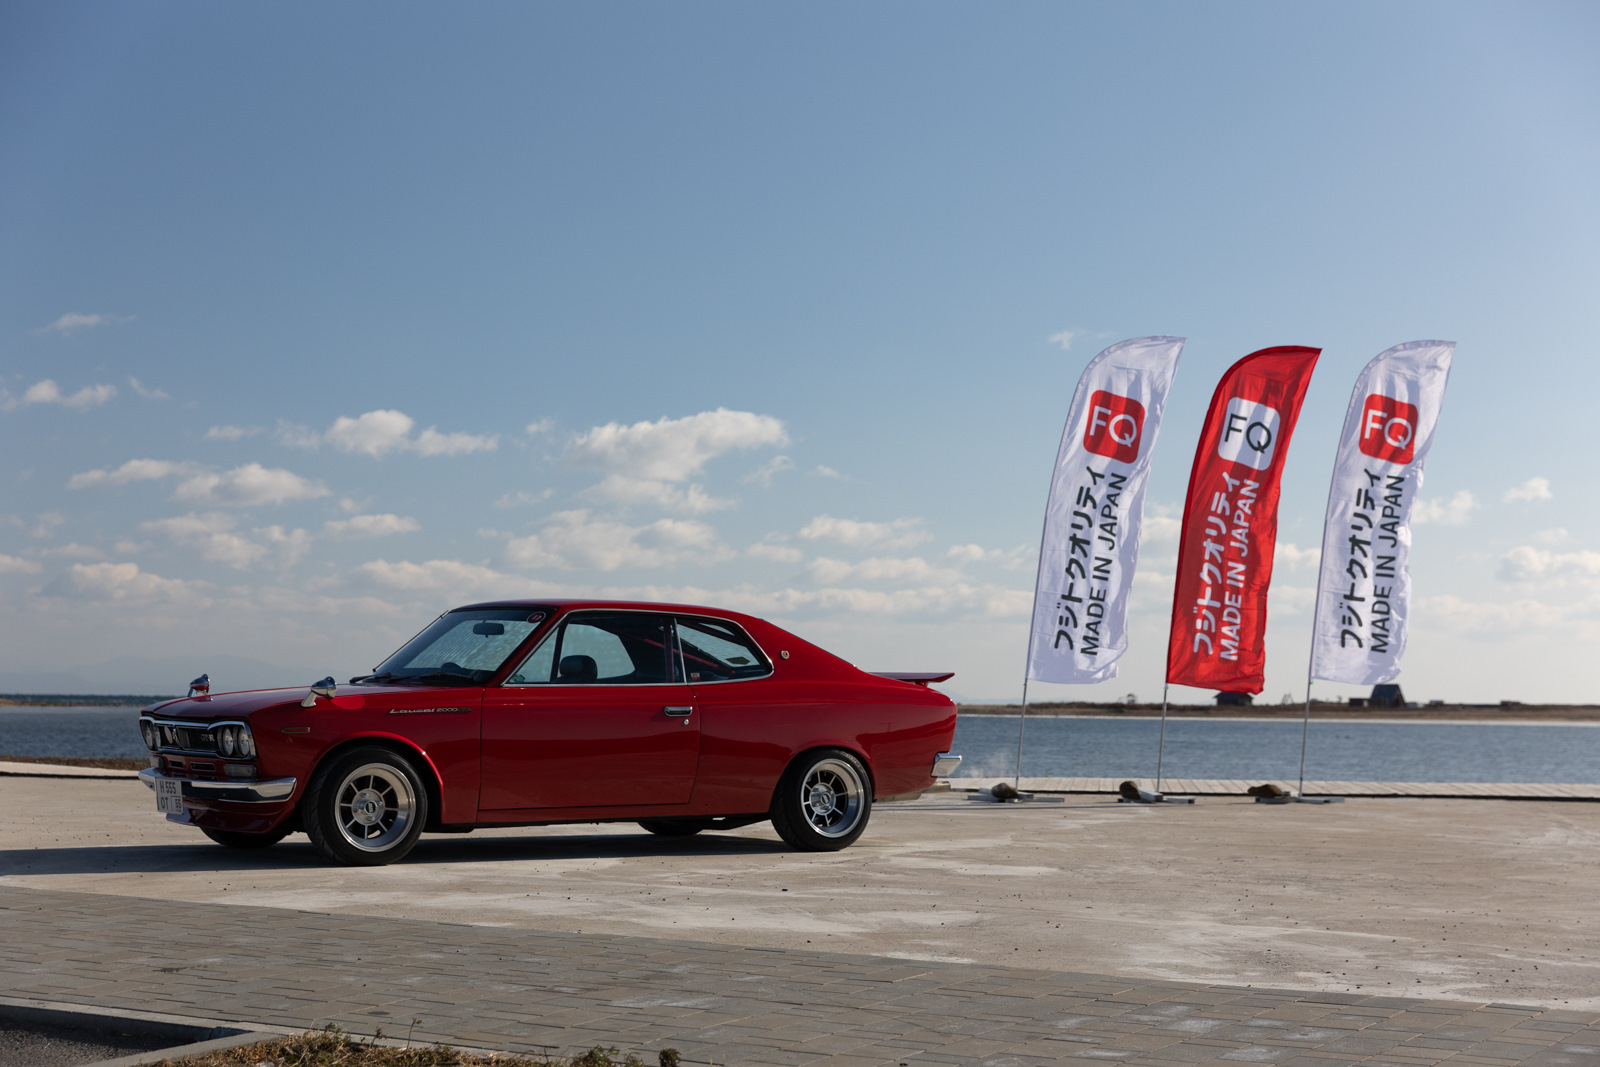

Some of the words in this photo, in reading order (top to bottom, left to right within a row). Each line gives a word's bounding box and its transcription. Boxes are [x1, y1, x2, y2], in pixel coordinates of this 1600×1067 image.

[1090, 405, 1138, 448] FQ
[1225, 413, 1272, 454] FQ
[1364, 408, 1413, 450] FQ
[1098, 472, 1128, 551] JAPAN
[1230, 478, 1260, 557] JAPAN
[1379, 475, 1405, 549] JAPAN
[1055, 466, 1105, 651] フジトクオリティ
[1093, 556, 1113, 582] IN
[1193, 471, 1241, 655] フジトクオリティ
[1226, 560, 1247, 589] IN
[1340, 468, 1381, 648] フジトクオリティ
[1375, 555, 1396, 579] IN
[1081, 587, 1107, 656] MADE
[1220, 591, 1242, 661] MADE
[1371, 584, 1392, 654] MADE
[159, 780, 165, 793] H
[165, 781, 177, 794] 555
[160, 796, 169, 810] OT
